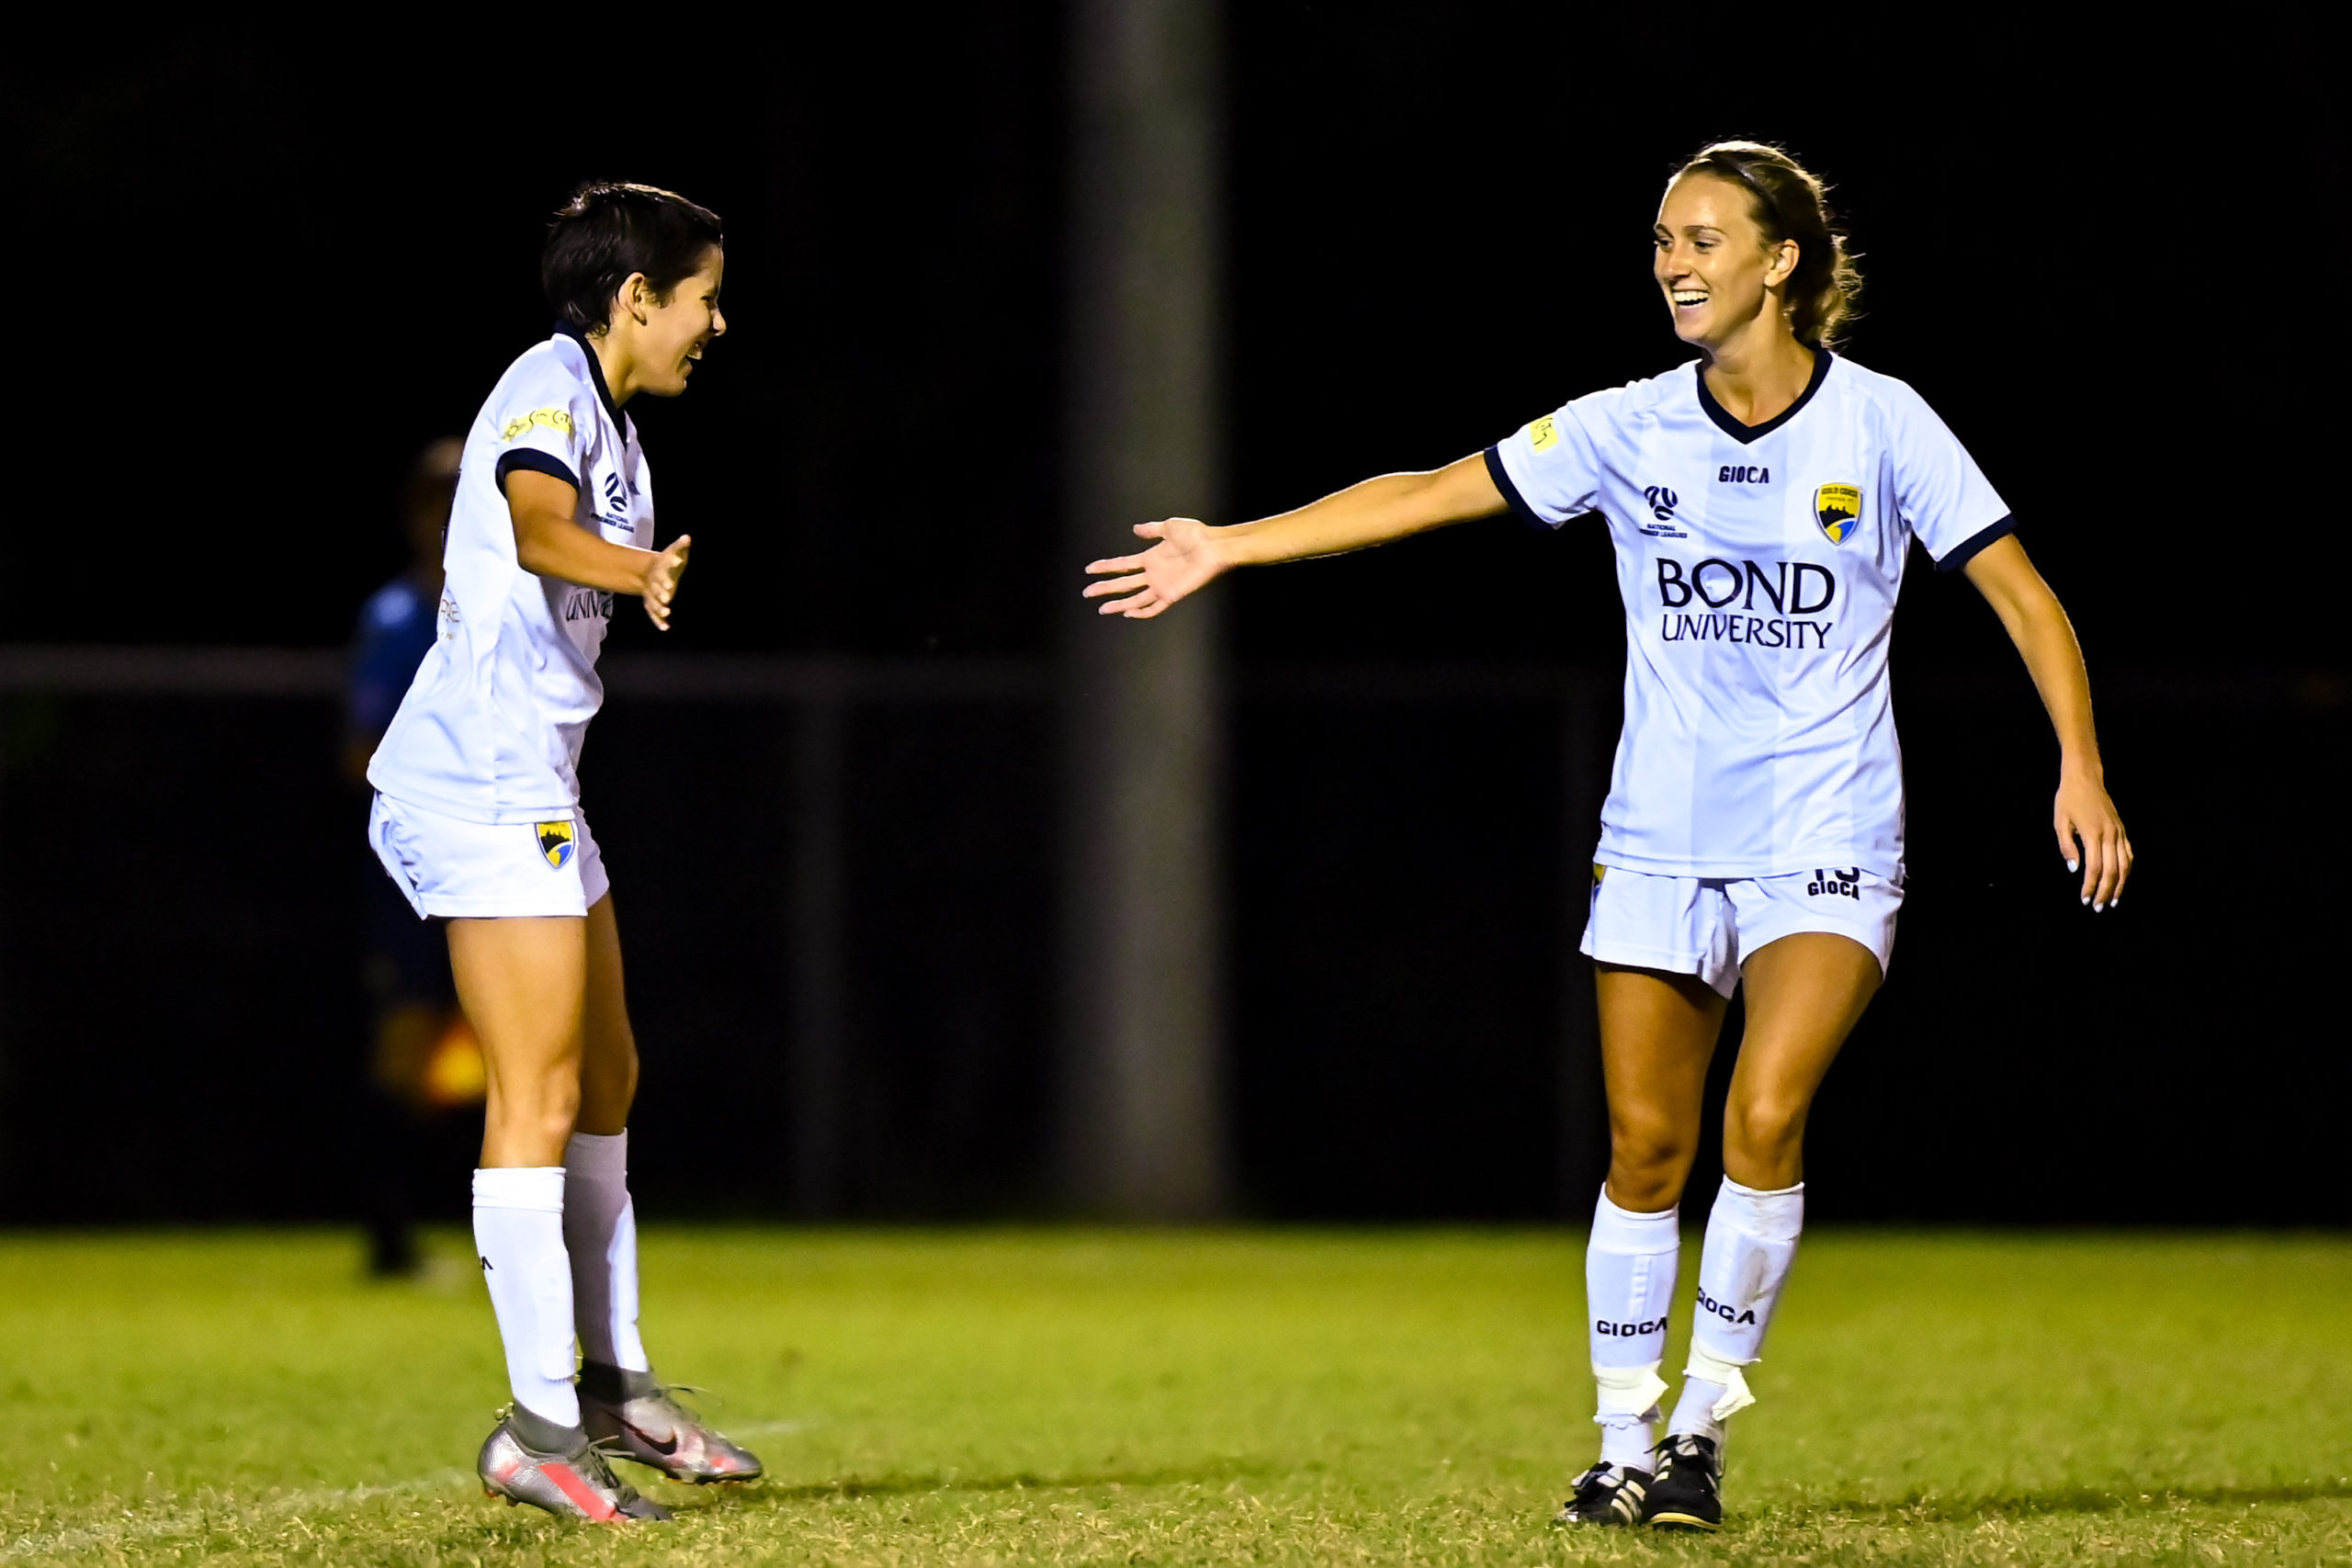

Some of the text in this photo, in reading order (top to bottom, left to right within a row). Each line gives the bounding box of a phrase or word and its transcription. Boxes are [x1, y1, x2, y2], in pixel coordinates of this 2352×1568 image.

[1718, 465, 1770, 484] GIOCA
[1656, 558, 1835, 615] BOND
[1661, 614, 1833, 649] UNIVERSITY
[1807, 880, 1860, 901] GIOCA
[1597, 1316, 1668, 1337] GIOCA
